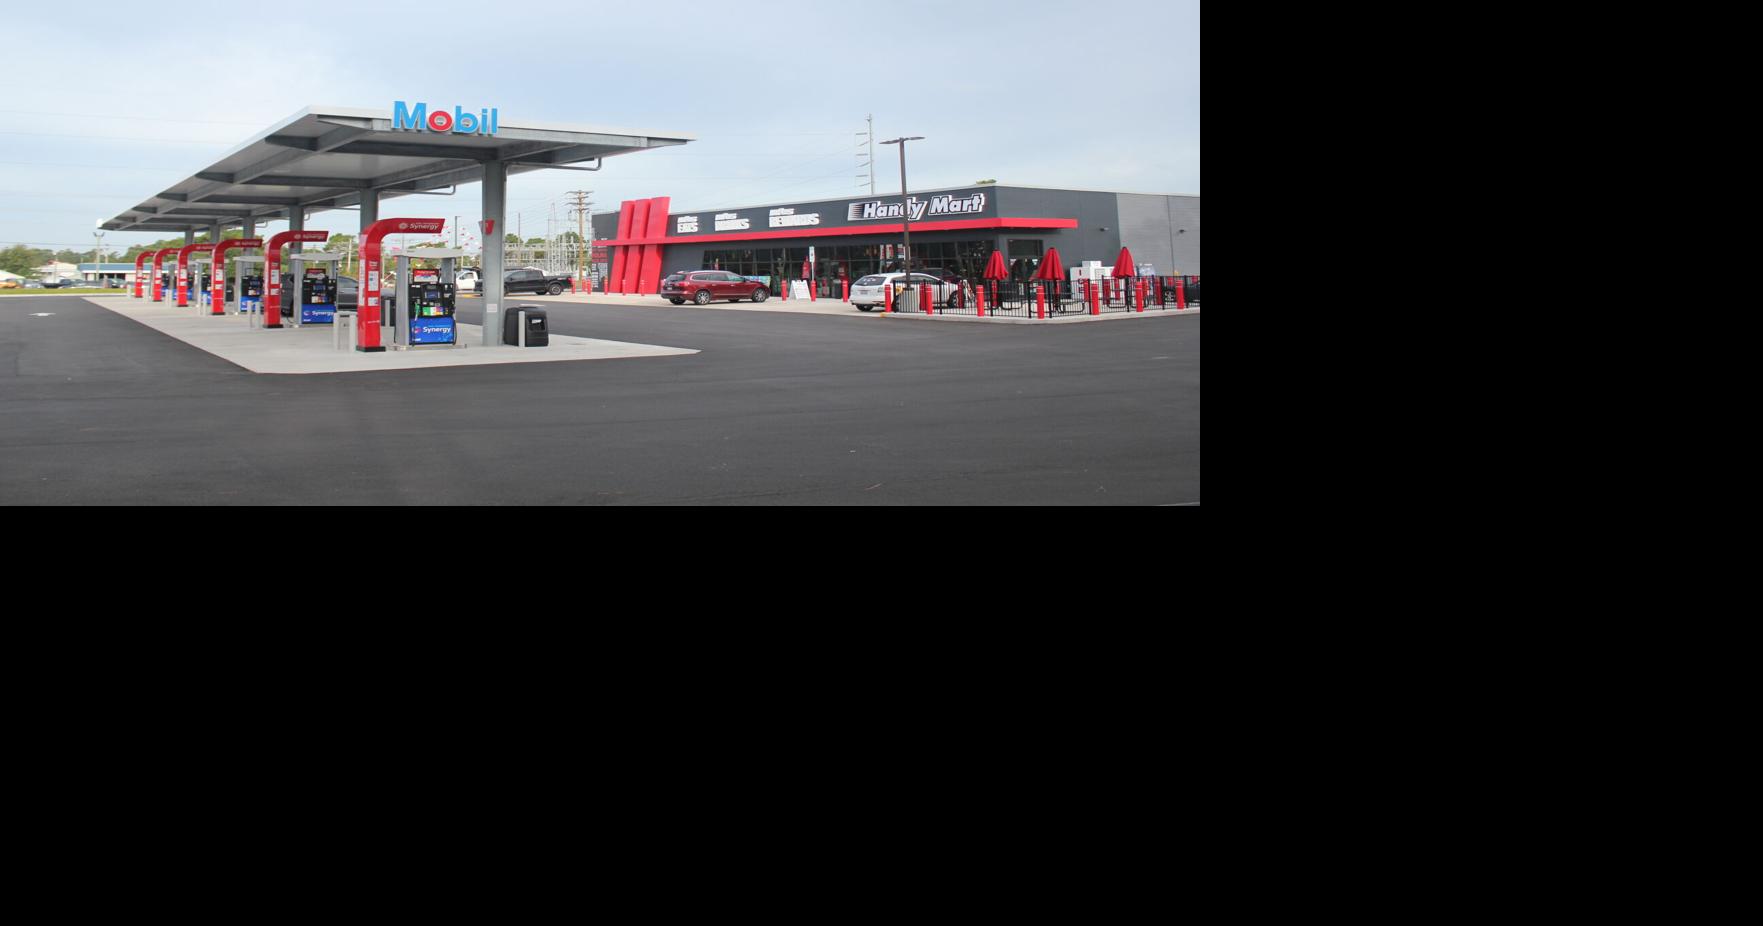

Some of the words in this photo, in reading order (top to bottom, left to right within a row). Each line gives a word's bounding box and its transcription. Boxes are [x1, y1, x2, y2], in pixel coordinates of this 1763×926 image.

[393, 100, 498, 134] Mobil
[929, 193, 984, 215] Mart
[409, 223, 440, 231] Synergy
[422, 326, 452, 334] Synergy
